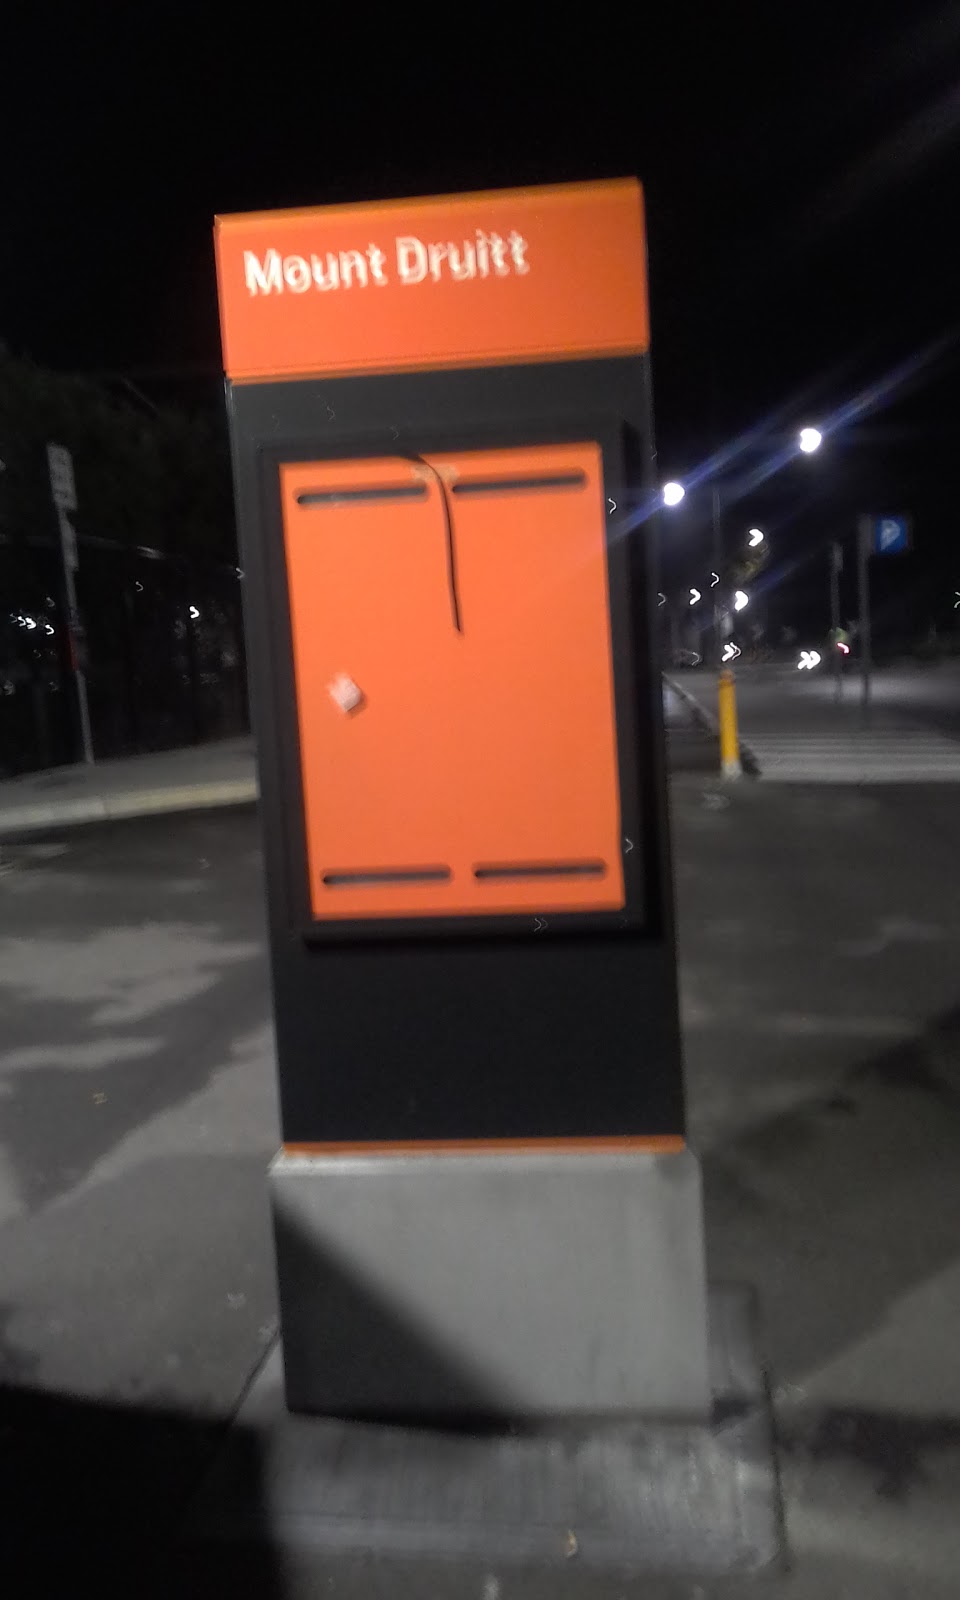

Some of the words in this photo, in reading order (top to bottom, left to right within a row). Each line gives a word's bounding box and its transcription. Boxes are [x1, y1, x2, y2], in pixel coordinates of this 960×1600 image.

[243, 244, 388, 297] Mount
[395, 229, 530, 284] Druitt
[880, 519, 901, 550] P
